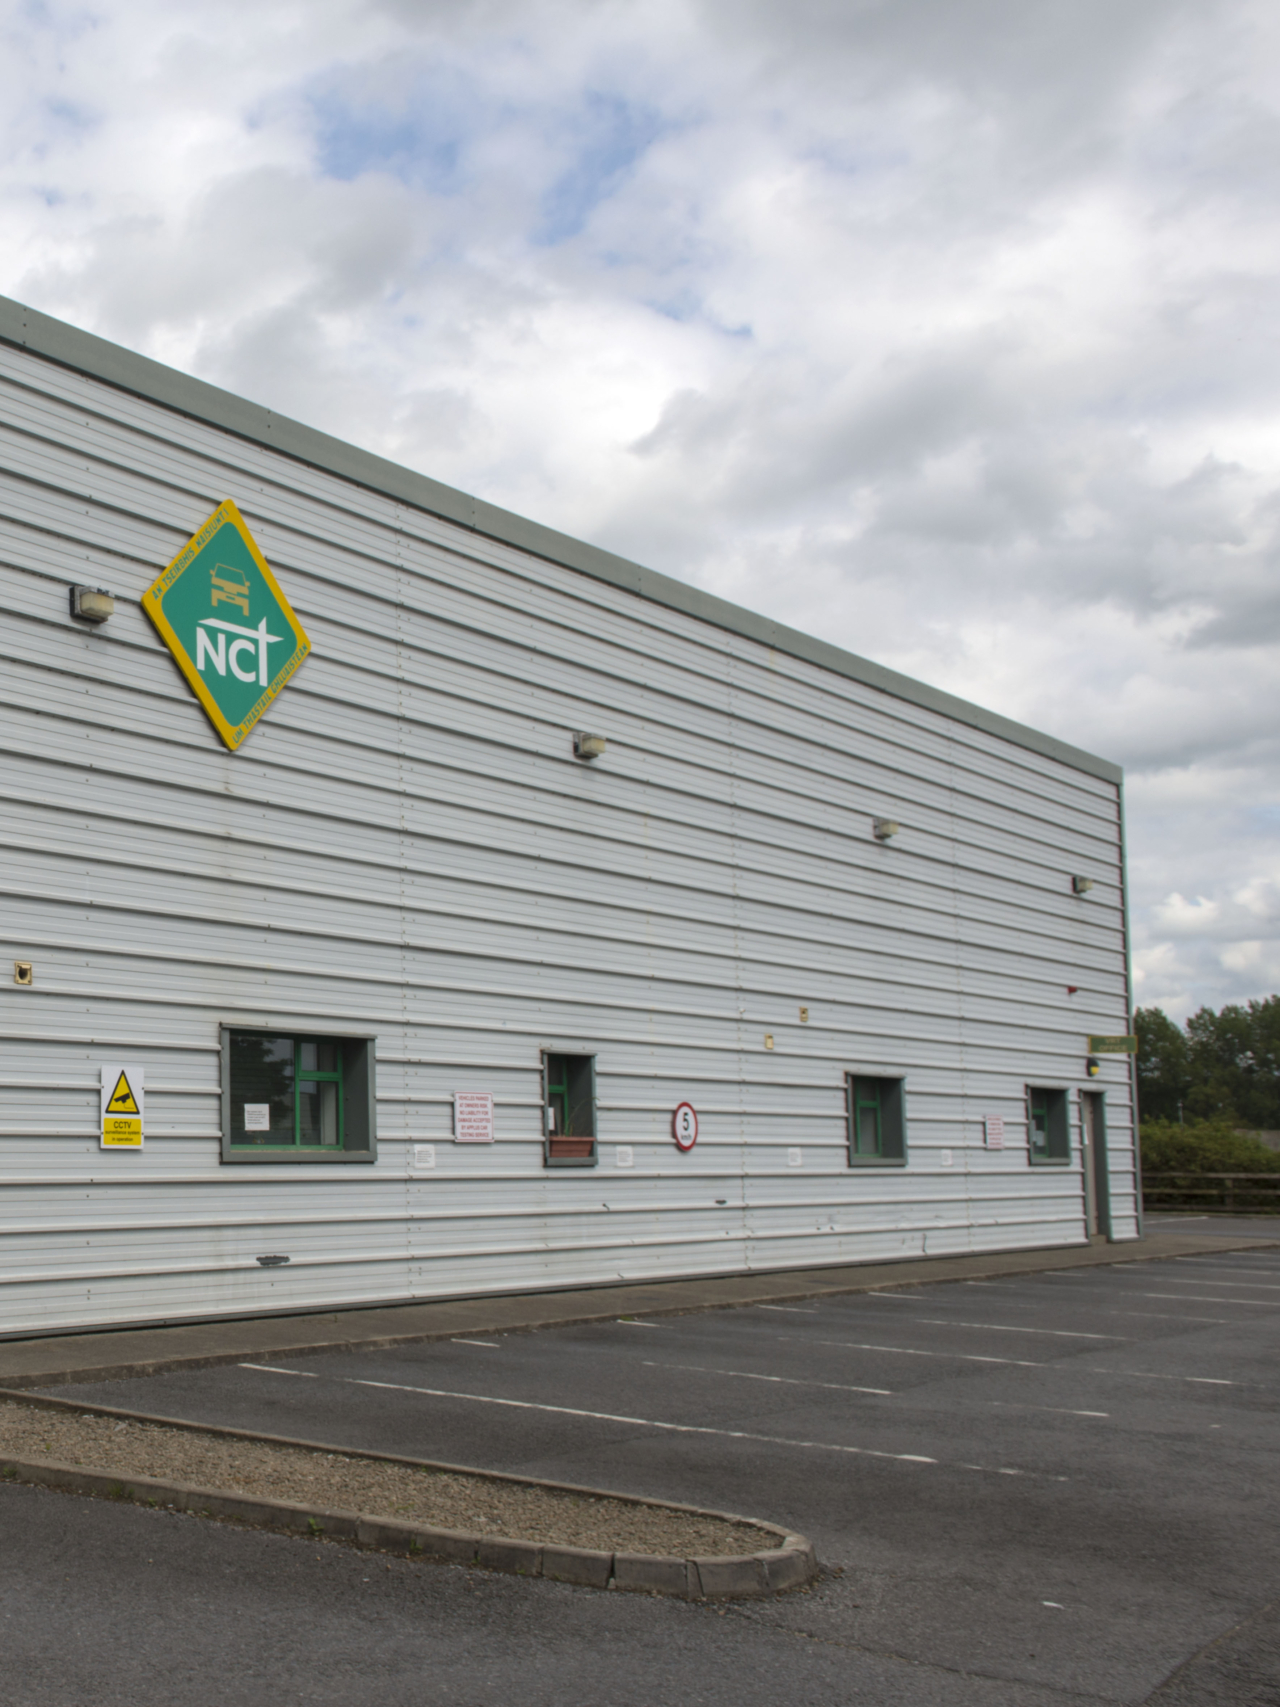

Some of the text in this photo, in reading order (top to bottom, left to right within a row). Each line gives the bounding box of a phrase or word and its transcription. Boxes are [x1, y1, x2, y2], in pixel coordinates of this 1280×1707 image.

[151, 584, 164, 601] AN
[161, 546, 195, 587] TSEIRBHIS
[196, 616, 284, 688] NCT
[231, 642, 309, 744] UM THASTAIL GHLUAISTEAN
[113, 1121, 132, 1130] CCTV
[683, 1112, 690, 1131] 5
